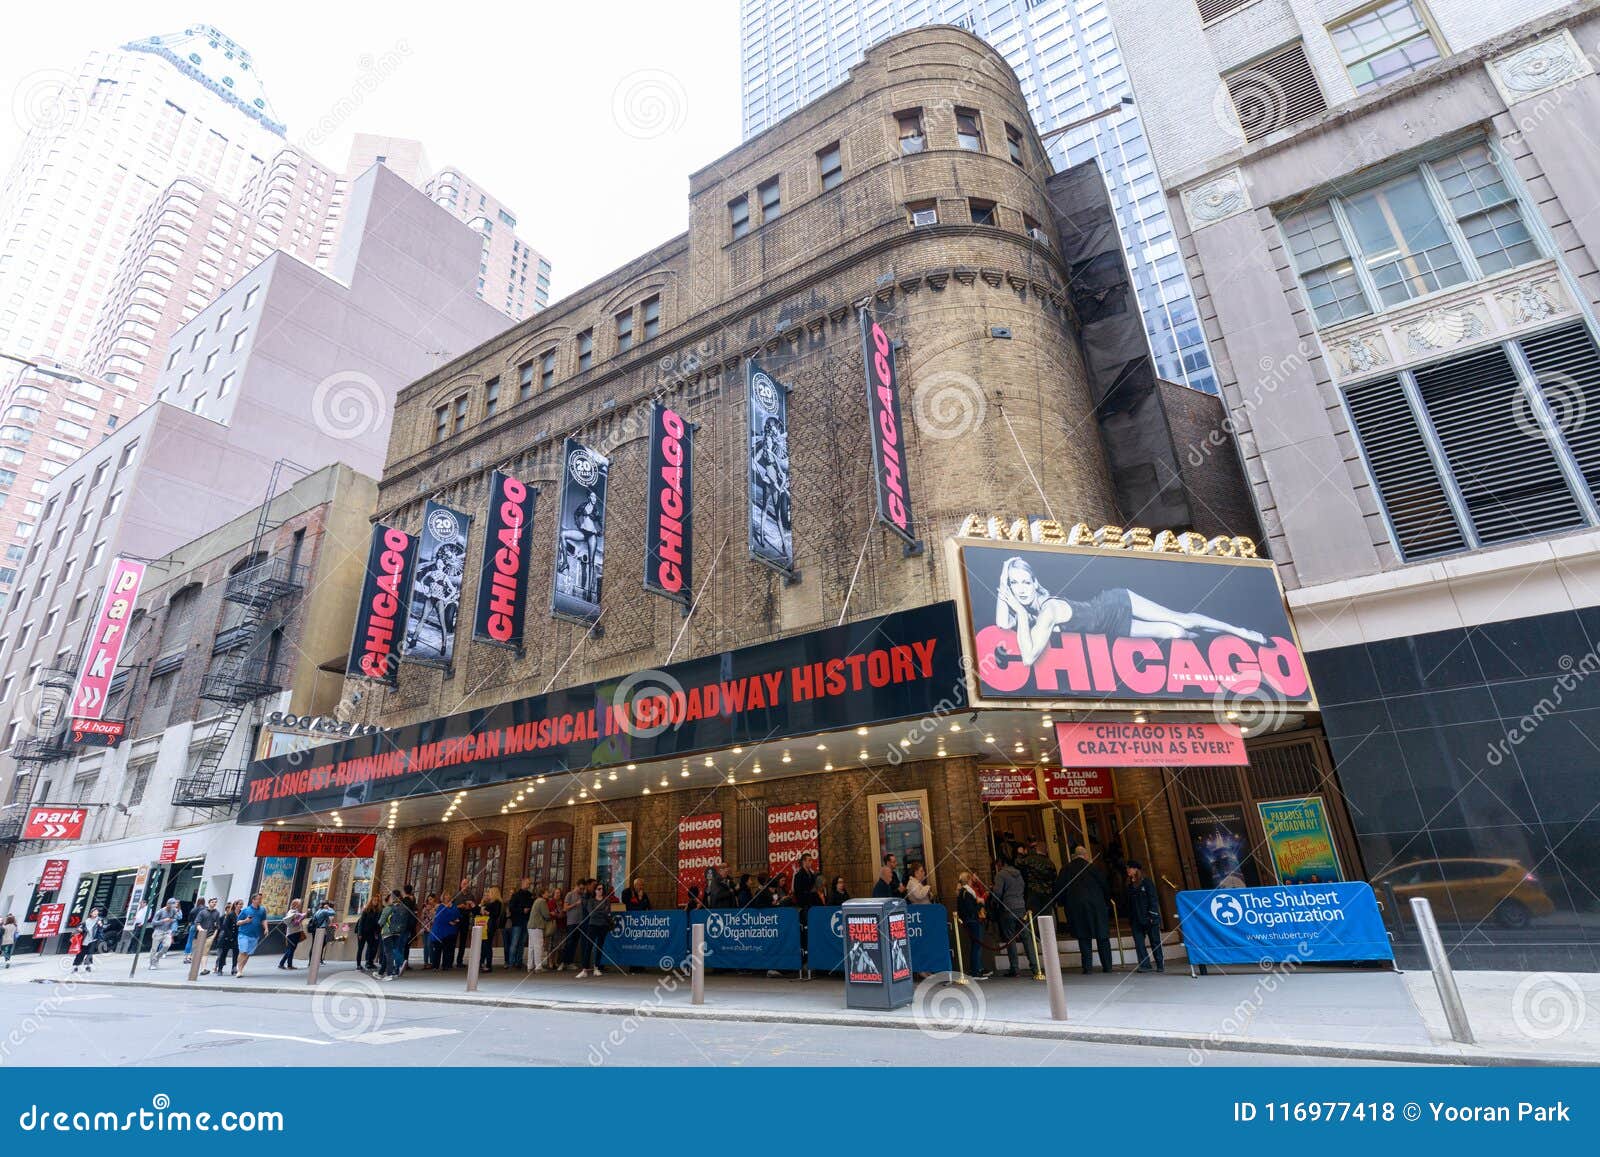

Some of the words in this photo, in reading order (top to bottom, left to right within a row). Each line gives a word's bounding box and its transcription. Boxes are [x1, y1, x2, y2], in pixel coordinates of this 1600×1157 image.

[872, 323, 907, 530] CHICAGO
[576, 459, 591, 472] 20
[658, 408, 685, 593] CHICAGO
[435, 518, 451, 529] 20
[959, 513, 1257, 558] AMBASSADOR
[488, 477, 527, 642] CHICAGO
[361, 528, 408, 678] CHICAGO
[88, 570, 137, 678] park
[975, 625, 1308, 697] CHICAGO
[75, 720, 90, 731] 24
[92, 722, 122, 733] hours
[249, 777, 271, 803] THE
[272, 750, 404, 798] LONGEST-RUNNING
[408, 729, 500, 773] AMERICAN
[504, 709, 598, 755] MUSICAL
[605, 702, 630, 737] IN
[635, 666, 785, 731] BROADWAY
[791, 638, 937, 703] HISTORY
[1170, 727, 1182, 739] IS
[1187, 727, 1204, 739] AS
[1078, 741, 1161, 754] CRAZY-FUN
[1169, 741, 1187, 754] AS
[1068, 779, 1087, 787] AND
[32, 810, 82, 824] park
[768, 809, 817, 823] CHICAGO
[878, 808, 921, 823] CHICAG
[1270, 810, 1303, 821] PARADISE
[1304, 808, 1315, 818] ON
[679, 818, 722, 833] CHICAGO
[1273, 818, 1319, 832] BROADWAY!
[768, 828, 818, 843] CHICAGO
[678, 837, 722, 851] CHICAGO
[678, 855, 722, 869] CHICAGO
[72, 880, 91, 913] park
[1240, 894, 1271, 909] The
[1274, 891, 1340, 908] Shubert
[39, 915, 49, 928] 8
[625, 915, 639, 926] The
[639, 914, 670, 926] Shubert
[724, 914, 740, 926] The
[742, 913, 778, 925] Shubert
[1244, 908, 1345, 927] Organization
[625, 926, 670, 940] Organization
[724, 926, 778, 940] Organization
[849, 924, 878, 933] SURE
[890, 921, 905, 931] SURE
[849, 933, 878, 942] THING
[1247, 931, 1320, 941] www.shubert.nyc
[850, 973, 882, 981] CHICAGO
